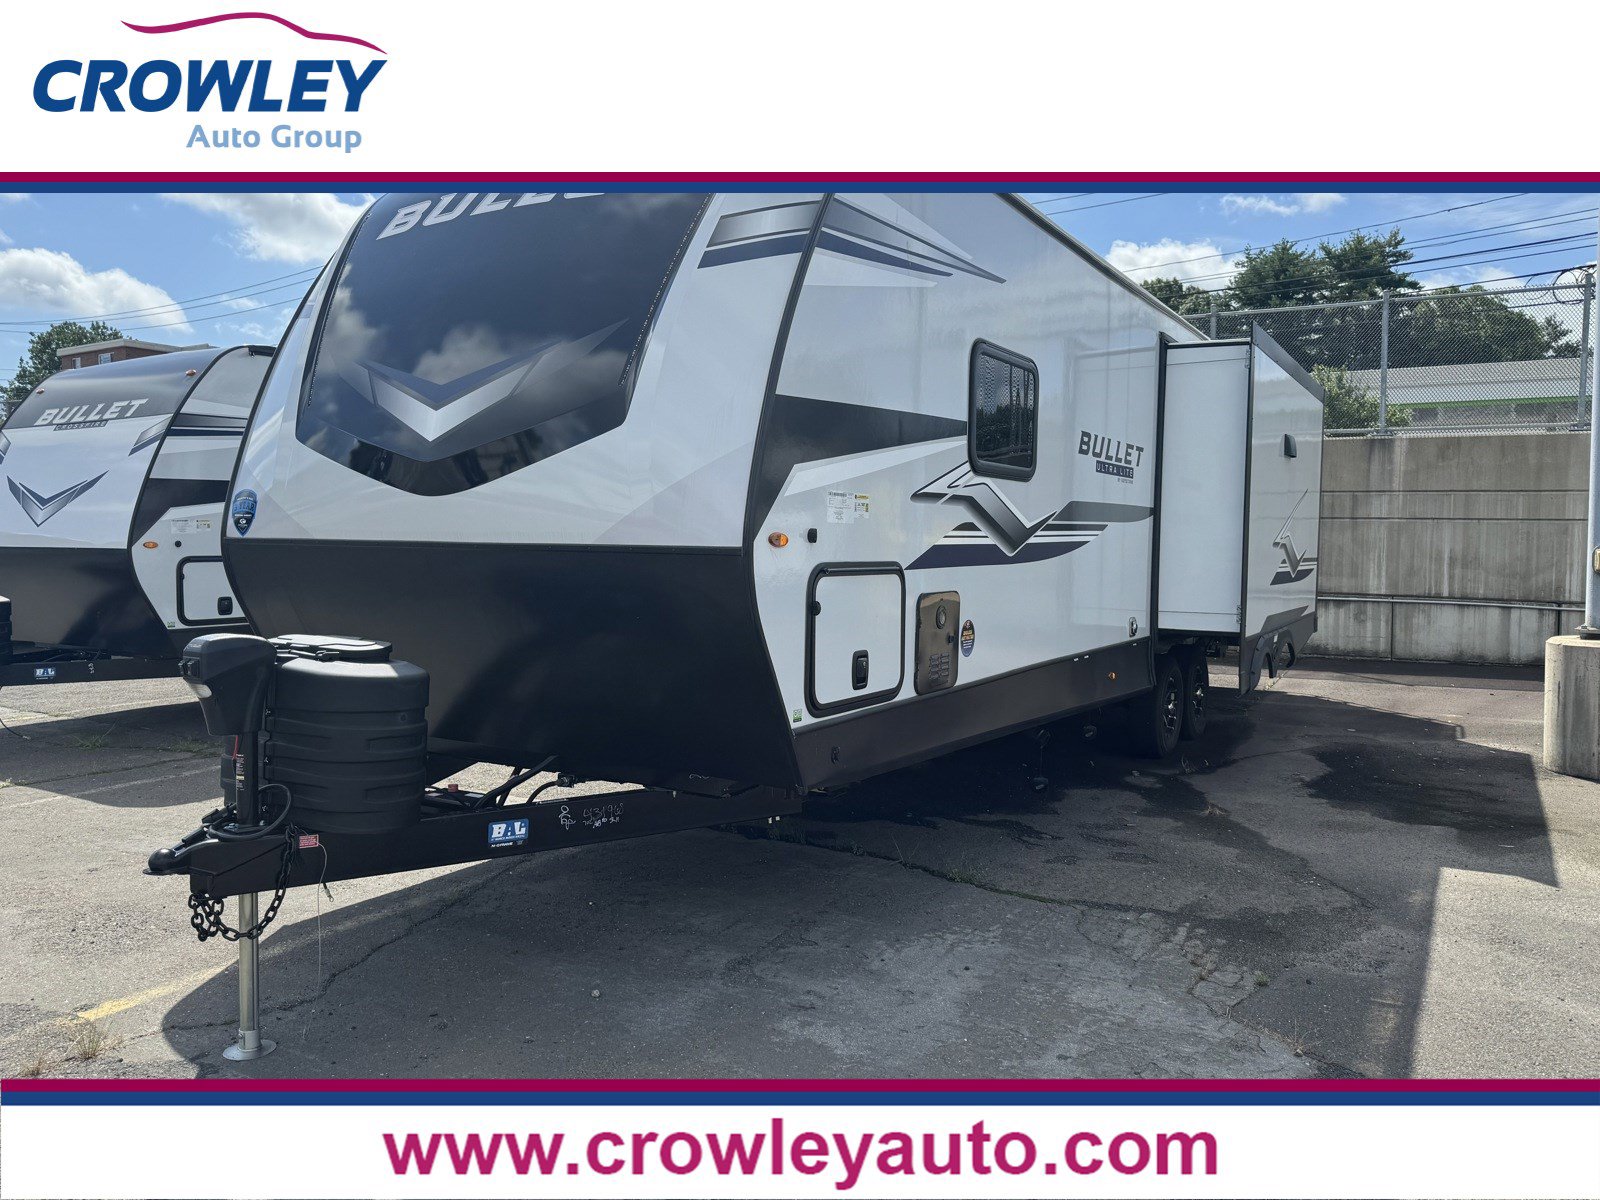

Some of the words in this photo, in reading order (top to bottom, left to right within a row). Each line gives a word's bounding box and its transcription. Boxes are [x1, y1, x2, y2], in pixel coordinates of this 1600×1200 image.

[34, 398, 149, 426] BULLET
[1078, 430, 1144, 466] BULLET
[1096, 462, 1117, 474] ULTRA
[1120, 467, 1133, 477] LITE
[491, 821, 528, 838] BAL
